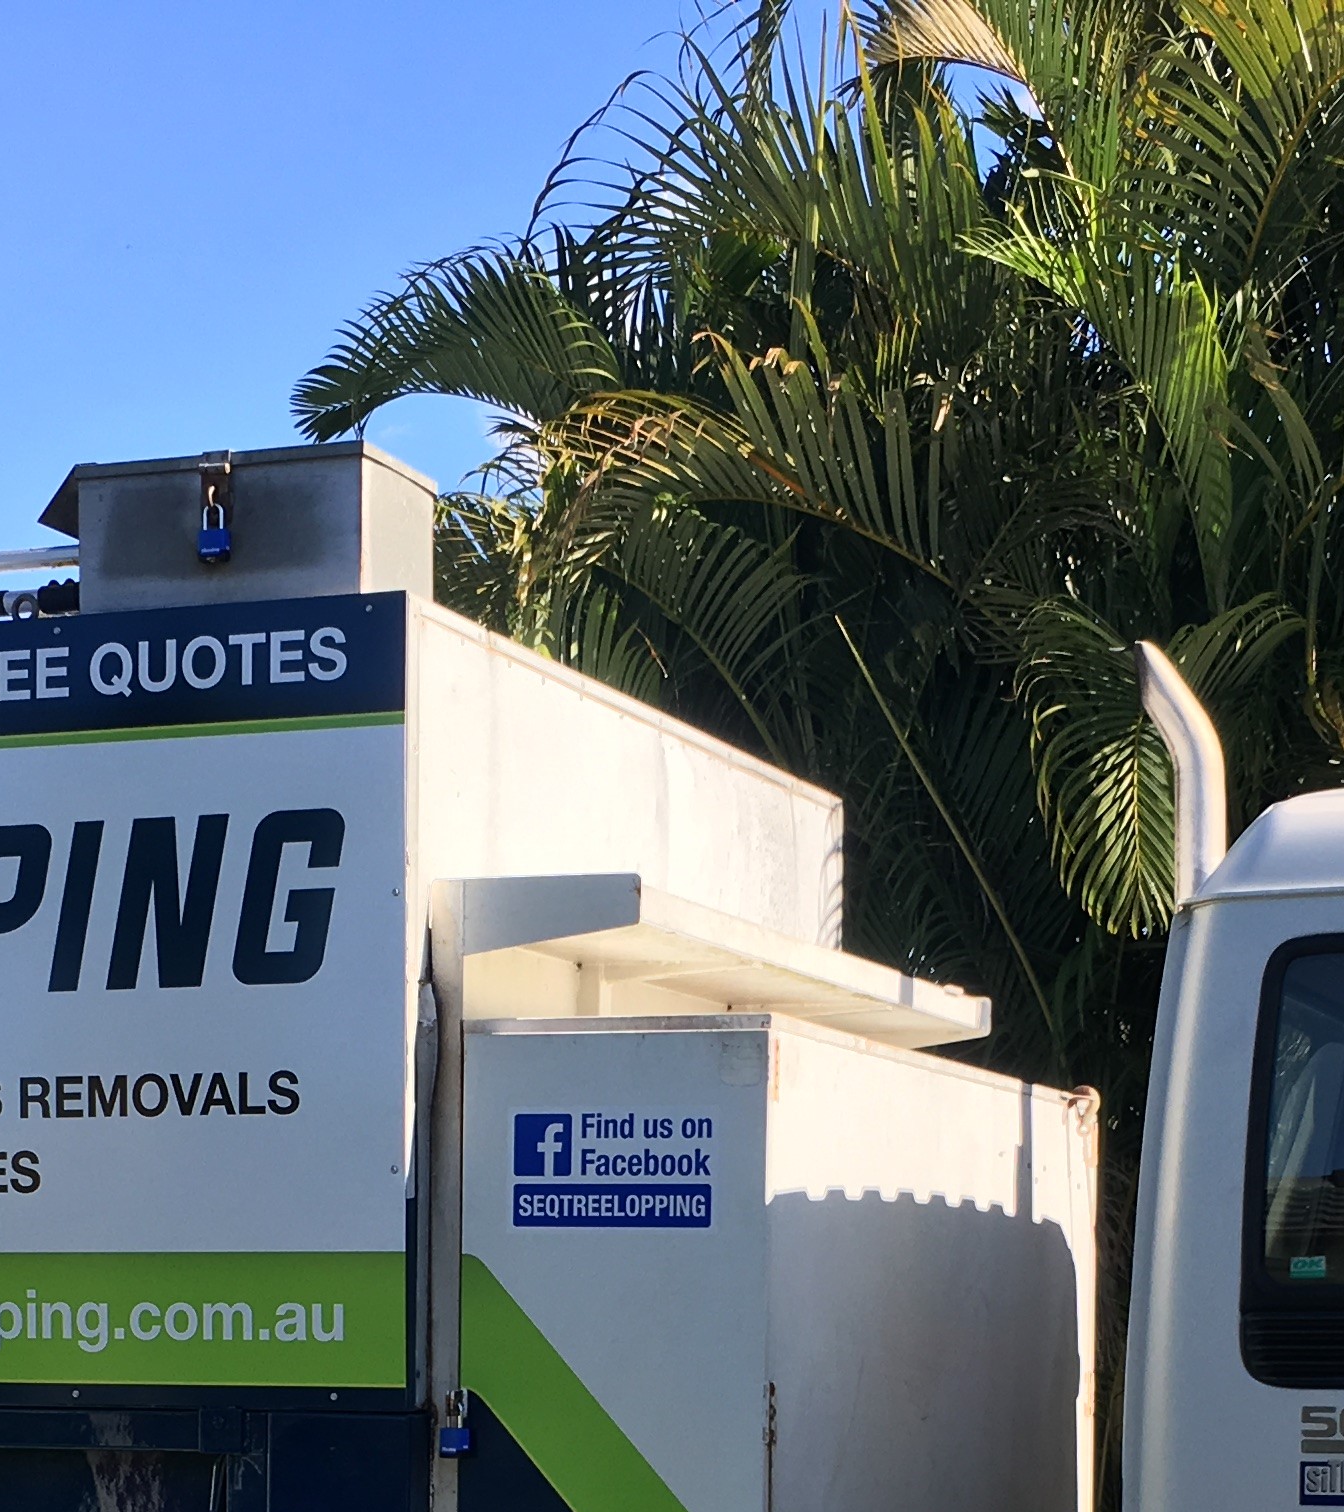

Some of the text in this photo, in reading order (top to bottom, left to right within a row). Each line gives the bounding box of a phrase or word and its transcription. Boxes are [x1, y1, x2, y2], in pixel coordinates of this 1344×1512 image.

[90, 627, 347, 697] QUOTES
[19, 1071, 300, 1118] REMOVALS
[581, 1112, 712, 1139] Find us on
[581, 1148, 710, 1176] Facebook
[518, 1194, 706, 1218] SEQTREELOPPING
